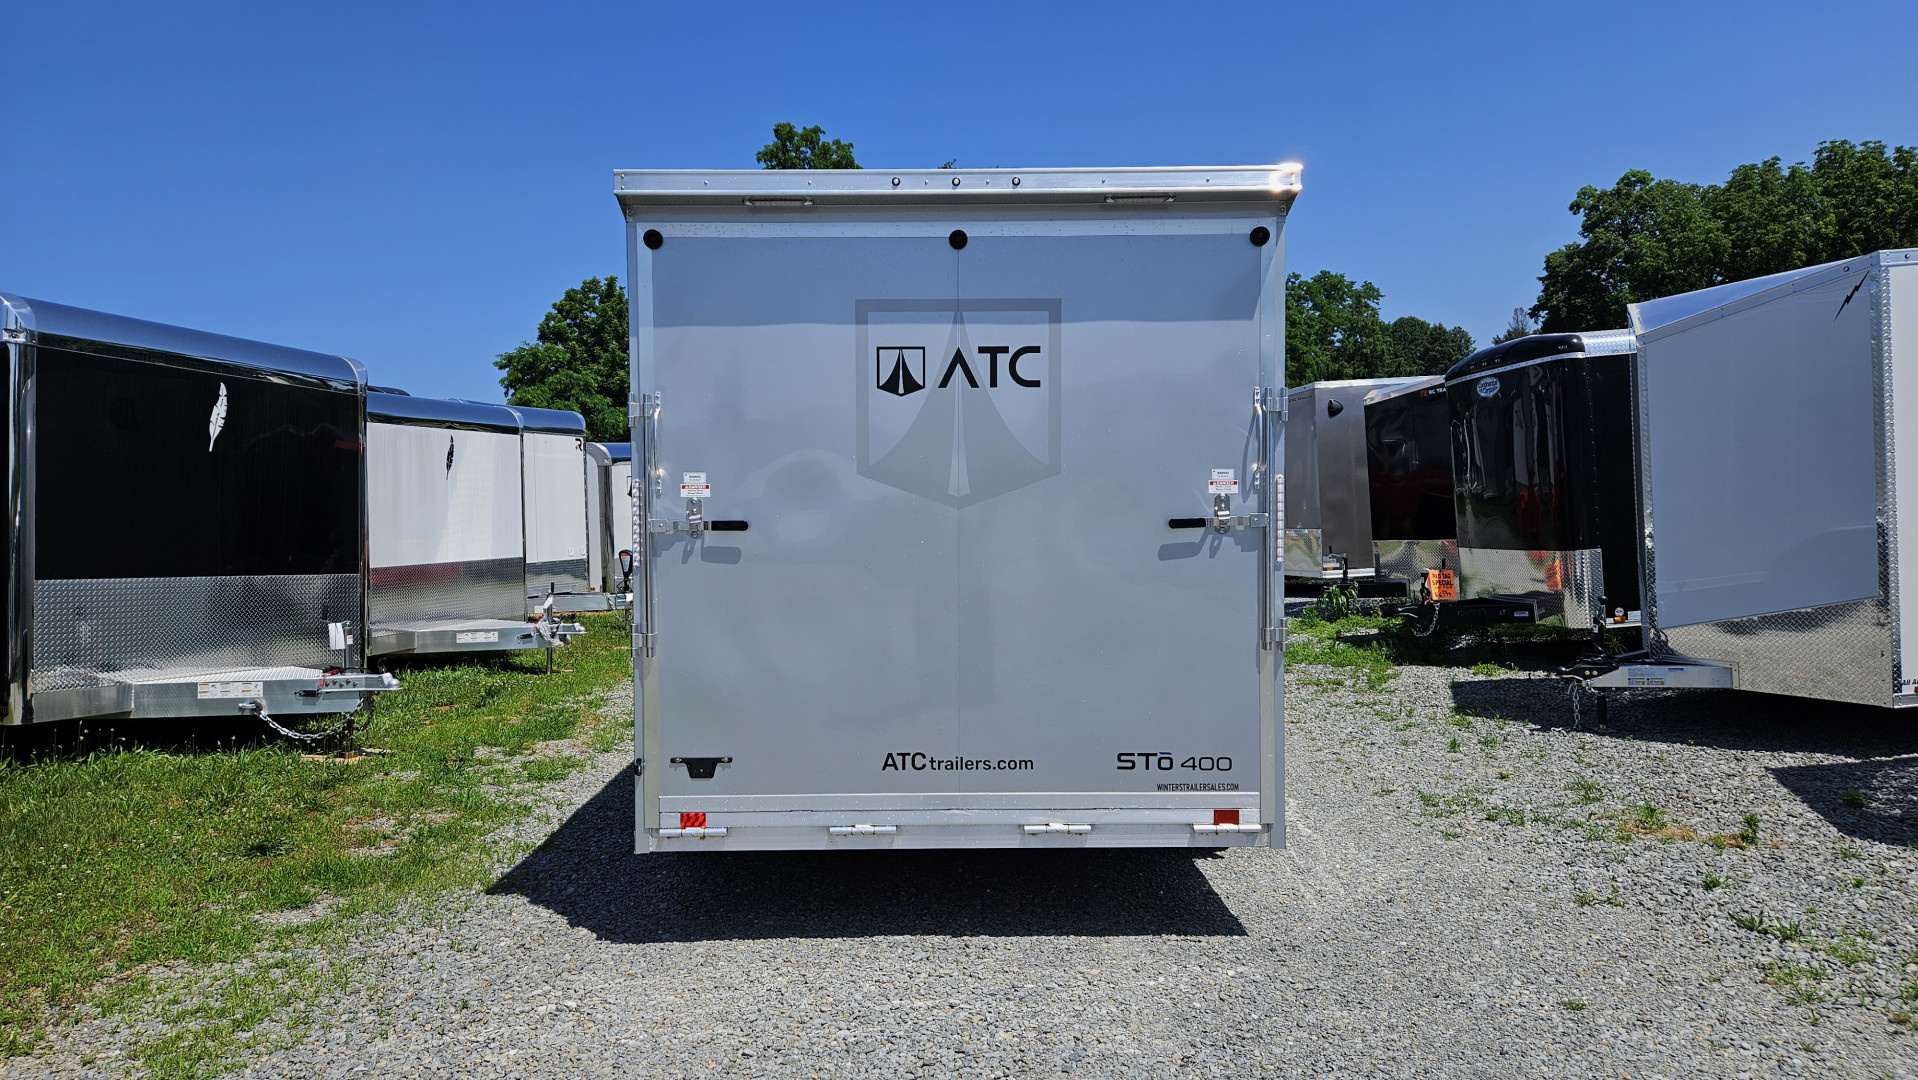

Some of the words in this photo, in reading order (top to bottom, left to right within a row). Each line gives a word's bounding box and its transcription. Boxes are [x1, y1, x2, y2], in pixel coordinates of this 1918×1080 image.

[938, 346, 1041, 388] ATC
[1180, 757, 1232, 771] 400
[1157, 783, 1240, 791] WINTERSTRAILERSALES.COM
